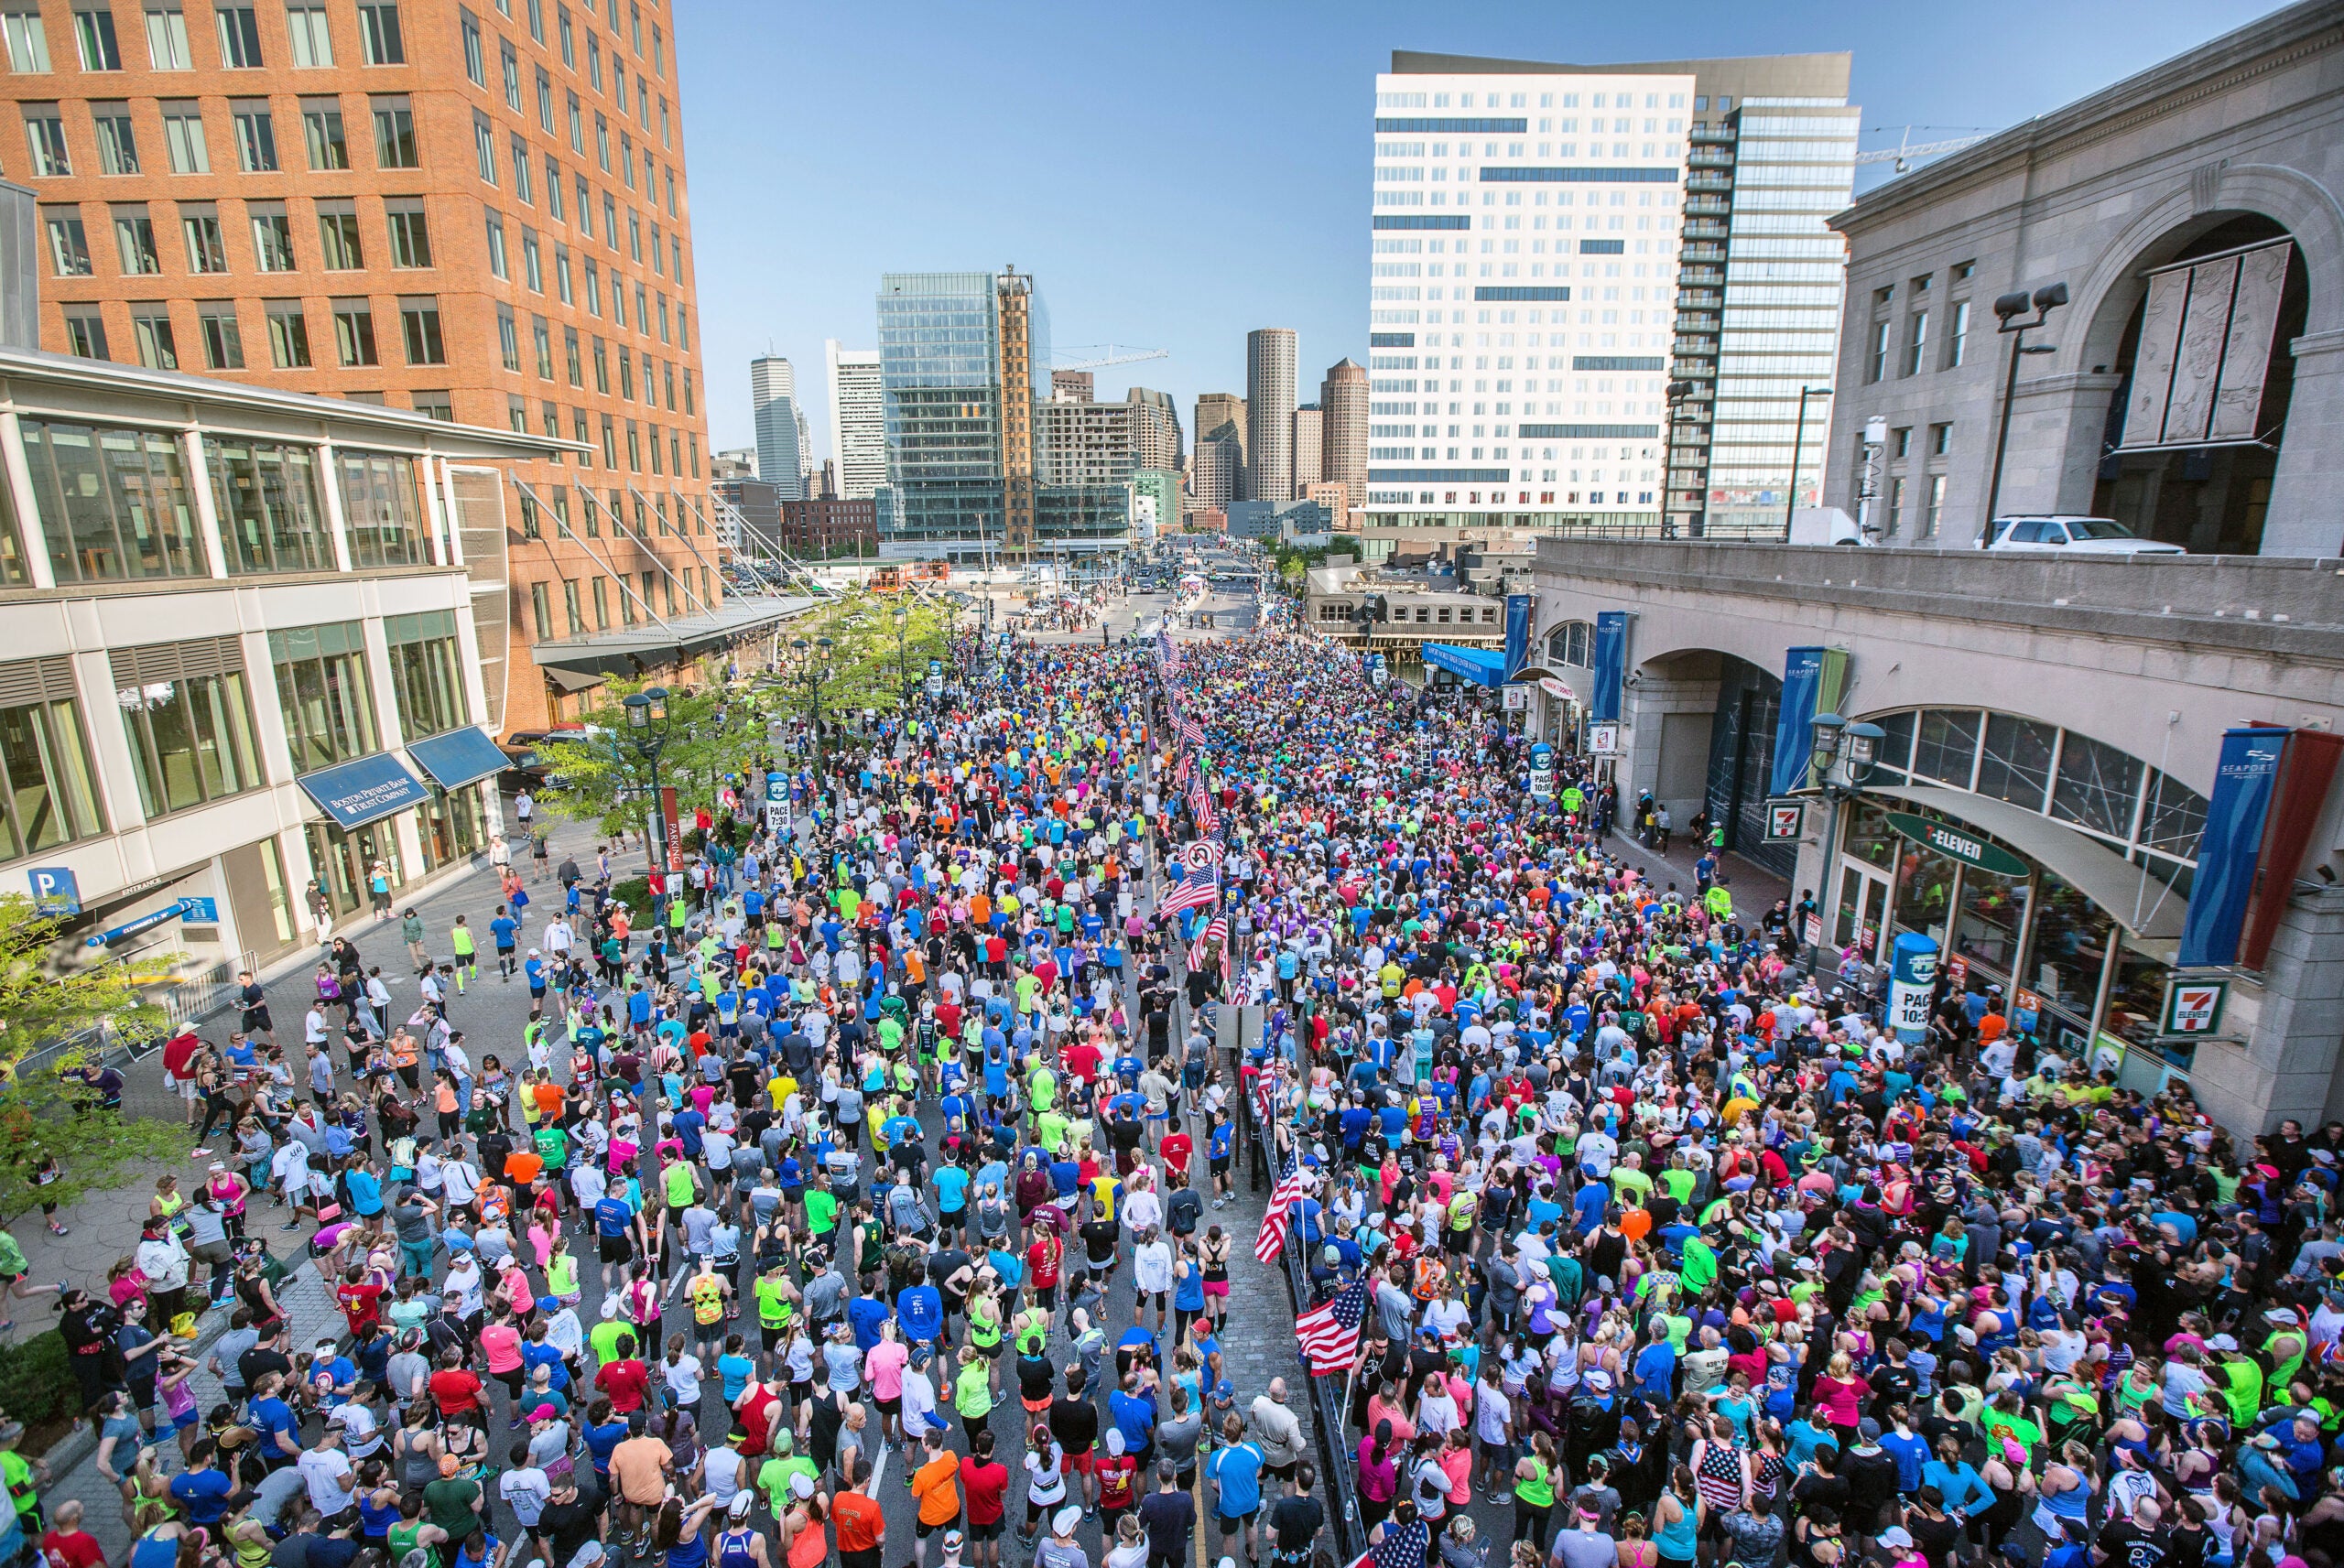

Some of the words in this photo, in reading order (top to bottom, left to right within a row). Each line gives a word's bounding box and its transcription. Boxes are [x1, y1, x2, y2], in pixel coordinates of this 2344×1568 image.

[2221, 764, 2273, 773] SEAPORT
[1535, 775, 1551, 784] PACE
[331, 793, 363, 808] BOSTON
[360, 784, 391, 799] PRIVATE
[388, 777, 411, 790] BANK
[352, 797, 379, 812] TRUST
[375, 787, 411, 804] COMPANY
[770, 806, 788, 816] PACE
[771, 816, 787, 826] 7:30
[668, 823, 681, 864] PARKING
[37, 873, 56, 899] P
[122, 877, 162, 896] ENTRANCE
[123, 917, 153, 935] CLEARANCE
[1807, 920, 1818, 932] FIRE
[1807, 928, 1818, 940] LANE
[1904, 992, 1930, 1008] PAC
[724, 1003, 731, 1011] 8
[1902, 1009, 1928, 1023] 10:3
[844, 1518, 852, 1528] 4
